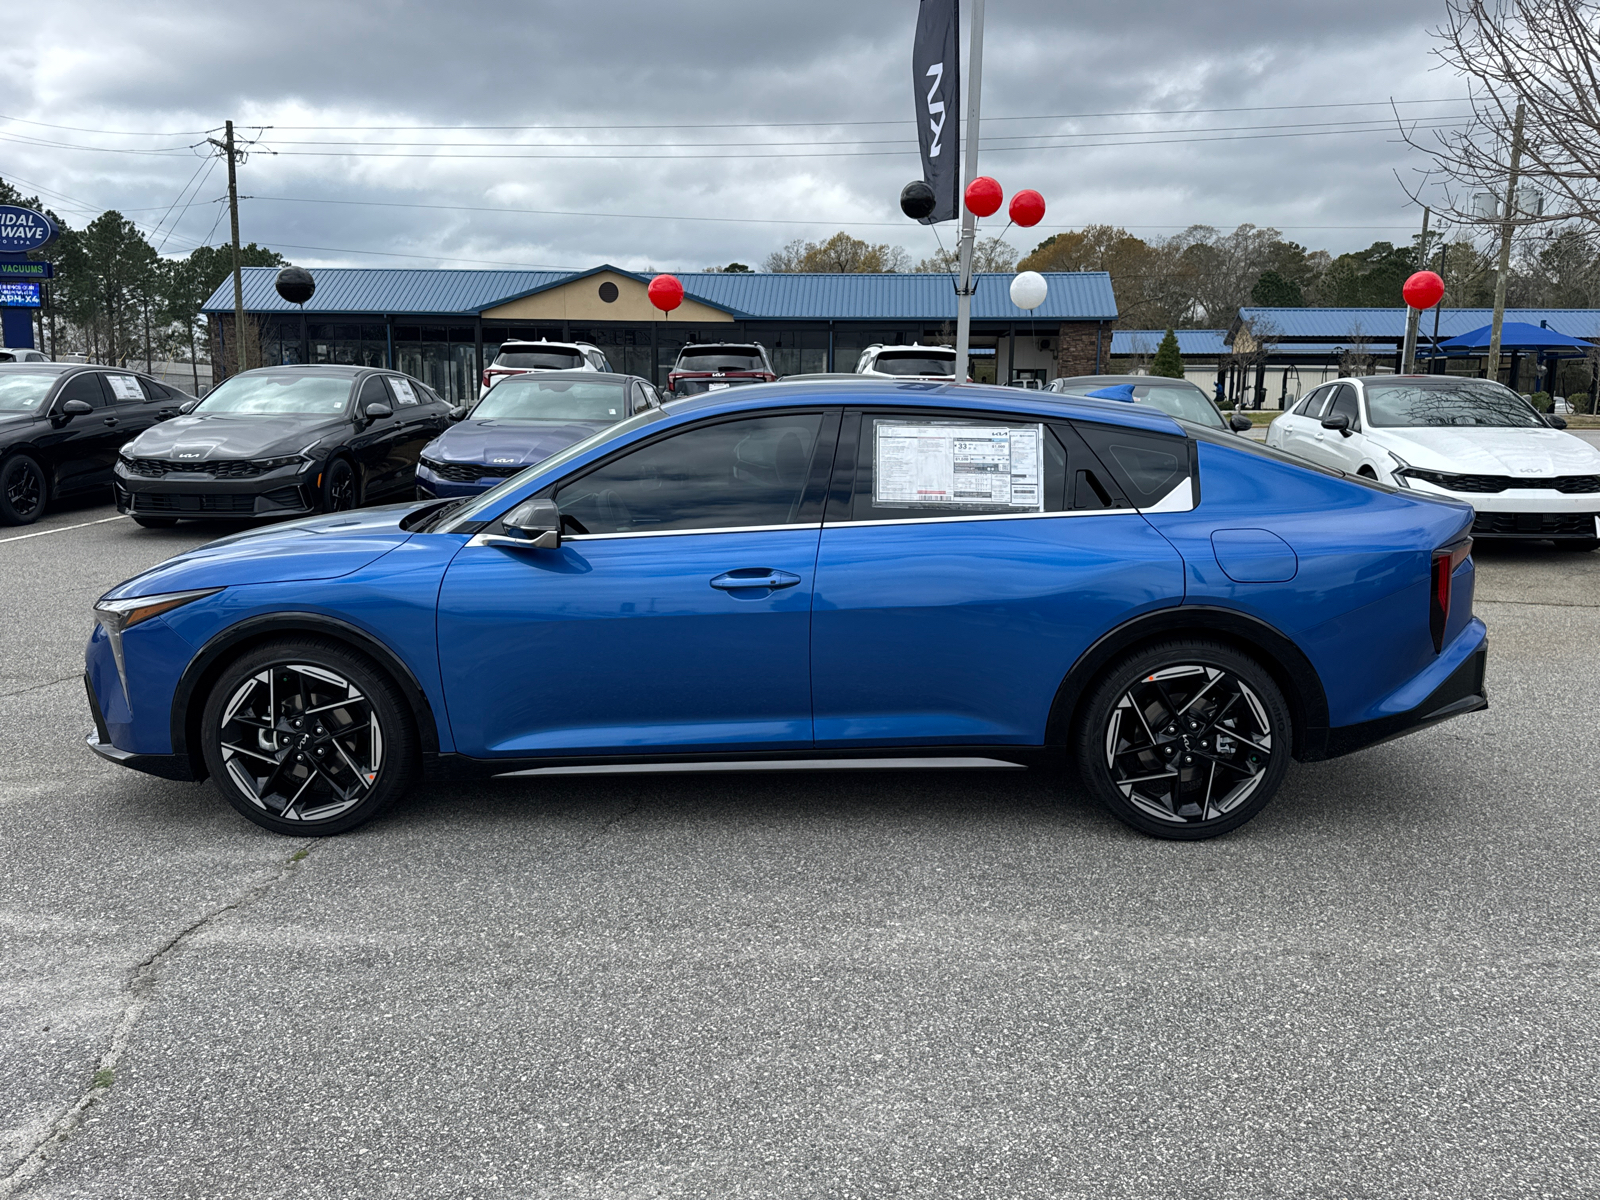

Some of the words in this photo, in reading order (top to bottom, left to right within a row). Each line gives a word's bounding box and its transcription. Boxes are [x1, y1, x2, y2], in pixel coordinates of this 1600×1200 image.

[1, 226, 44, 239] WAVE
[1, 264, 44, 274] VACUUMS
[0, 294, 39, 304] APH-X4
